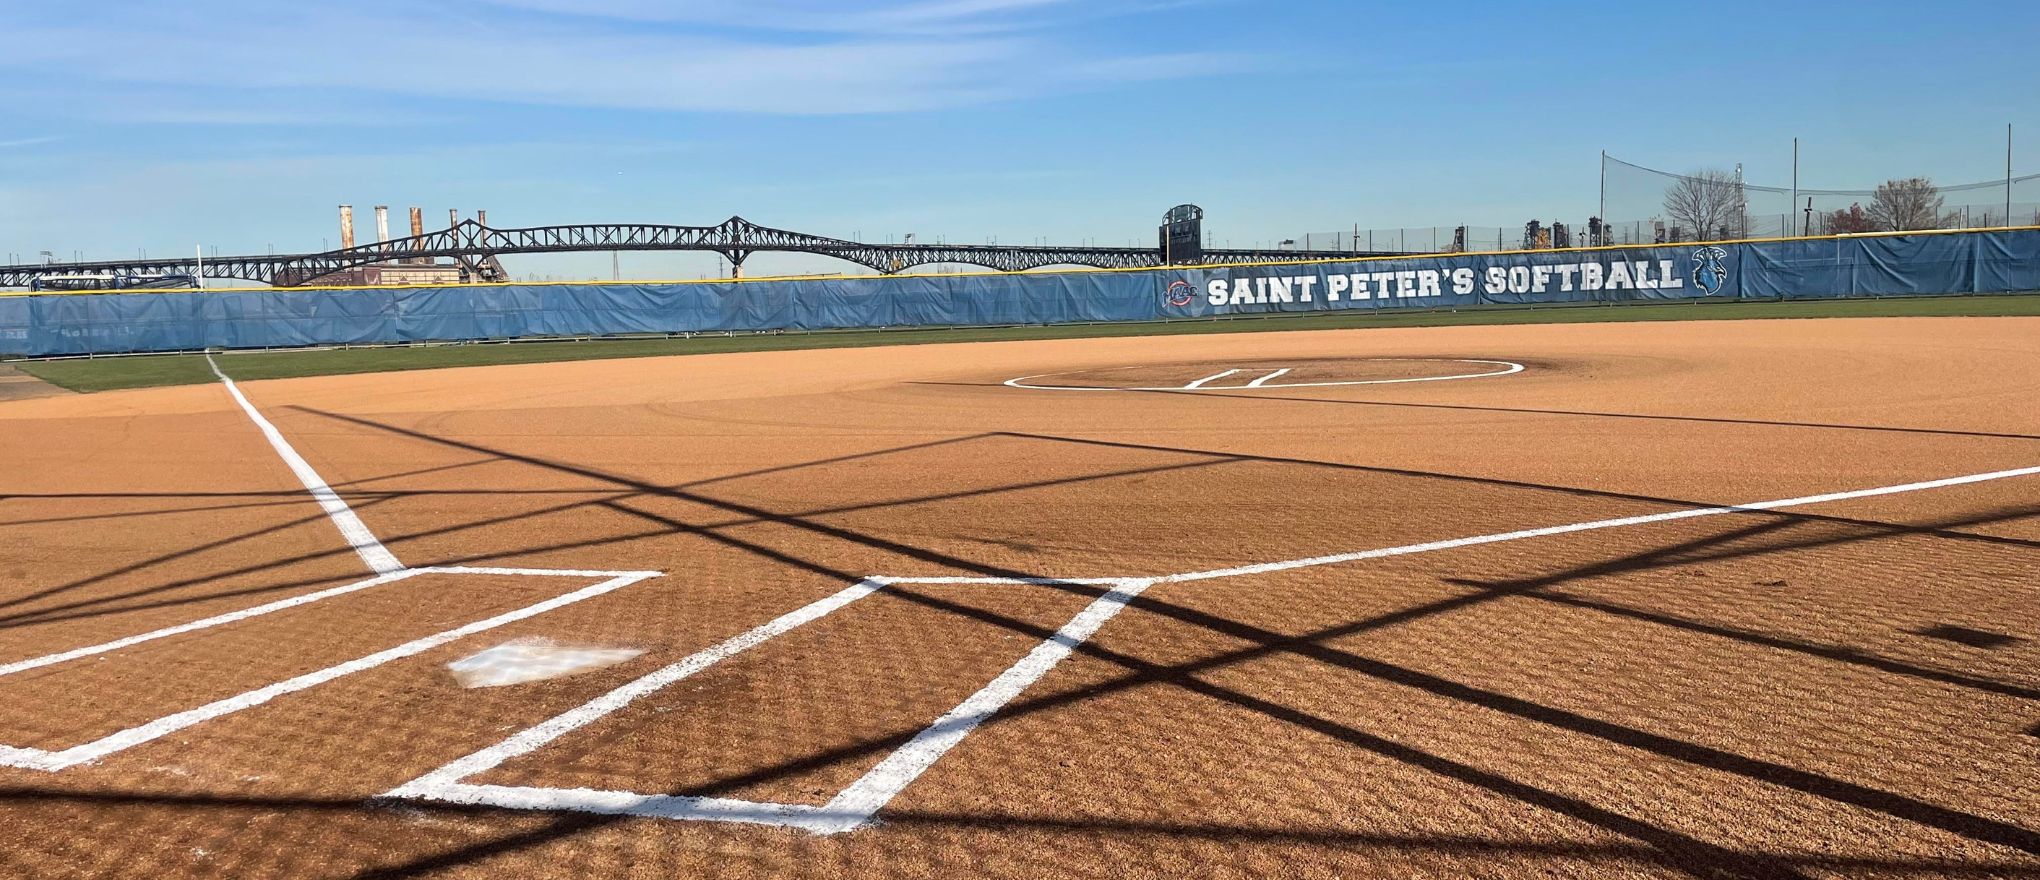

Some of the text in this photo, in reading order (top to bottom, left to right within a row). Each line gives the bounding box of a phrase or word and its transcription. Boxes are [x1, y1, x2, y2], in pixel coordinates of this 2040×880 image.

[1207, 259, 1684, 306] SAINT PETER'S SOFTBALL
